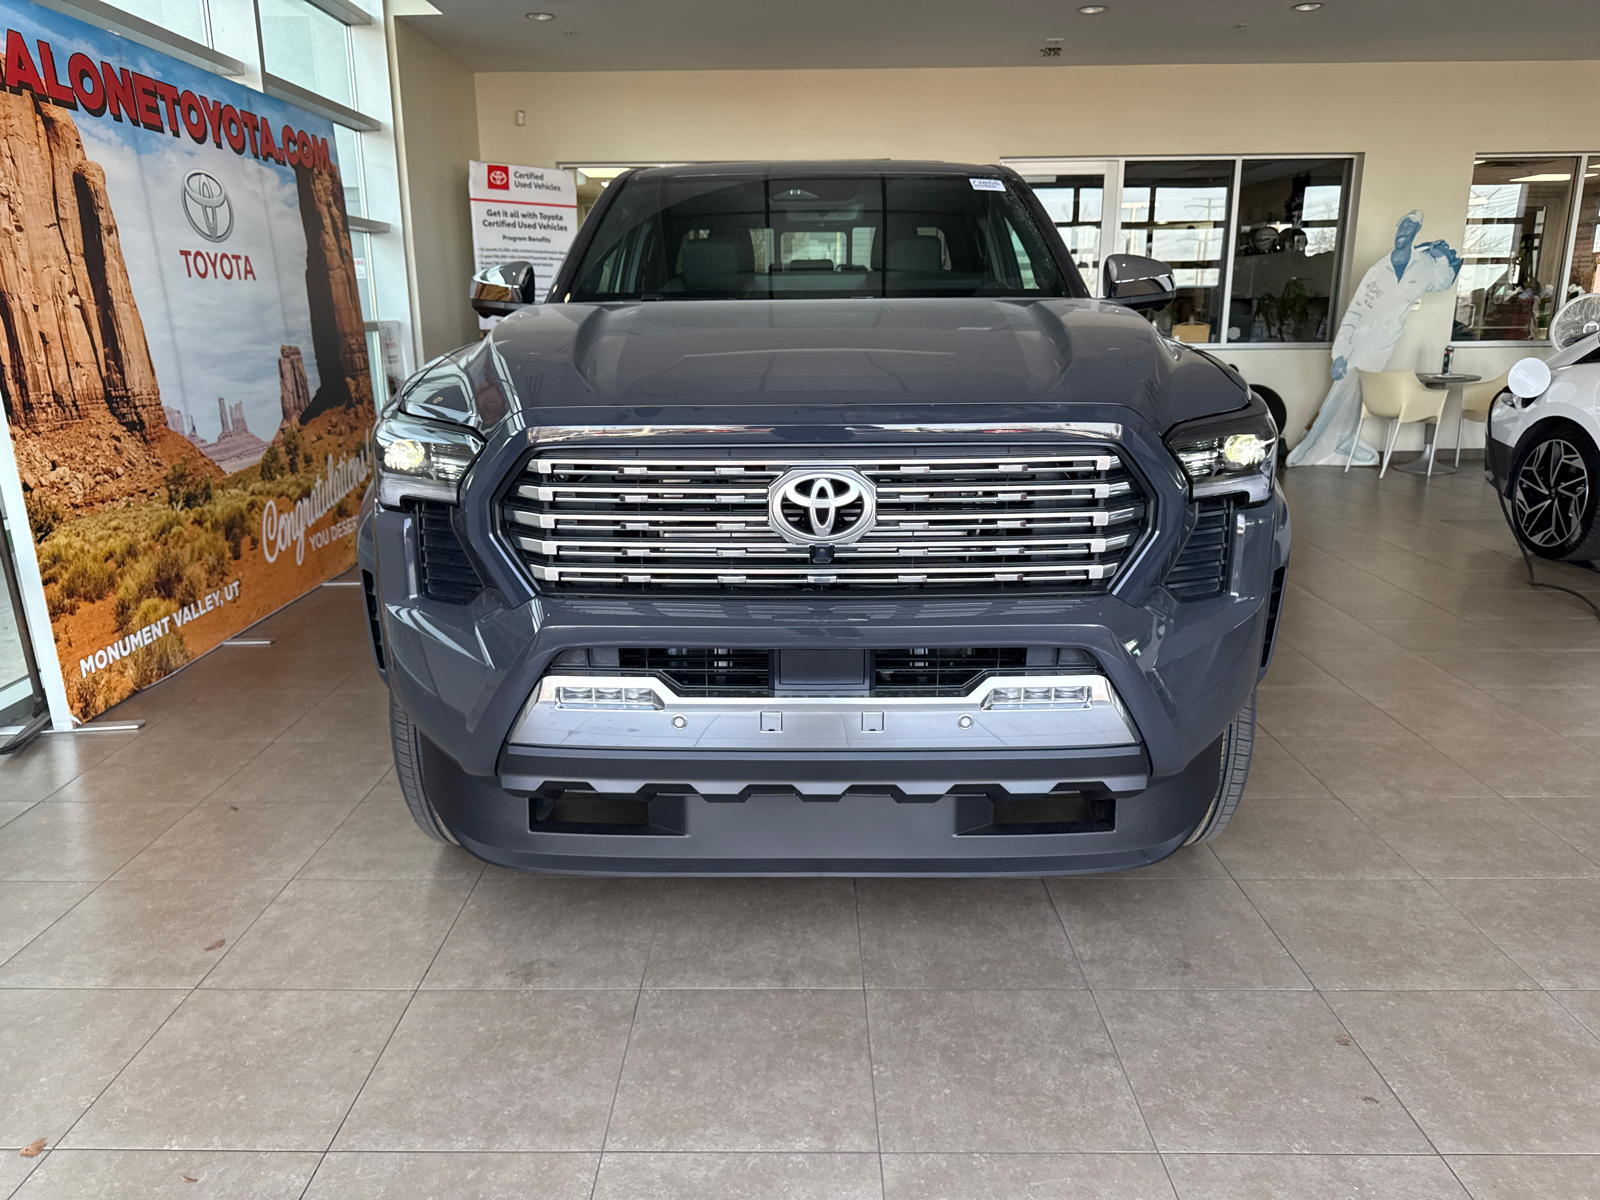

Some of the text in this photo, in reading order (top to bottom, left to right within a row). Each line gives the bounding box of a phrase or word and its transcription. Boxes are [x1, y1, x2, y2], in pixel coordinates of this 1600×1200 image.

[0, 28, 331, 175] ALONETOYOTA.COM
[513, 171, 544, 181] Certified
[514, 181, 561, 191] Used Vehicles
[486, 209, 501, 218] Get
[510, 211, 520, 219] all
[521, 212, 538, 221] with
[539, 213, 563, 222] Toyota
[482, 219, 568, 232] Certified Used Vehicles
[502, 235, 551, 244] Program Benefits
[179, 250, 257, 281] TOYOTA
[262, 427, 372, 566] Congratulations!
[309, 529, 330, 551] YOU
[78, 581, 240, 679] MONUMENT VALLEY, UT
